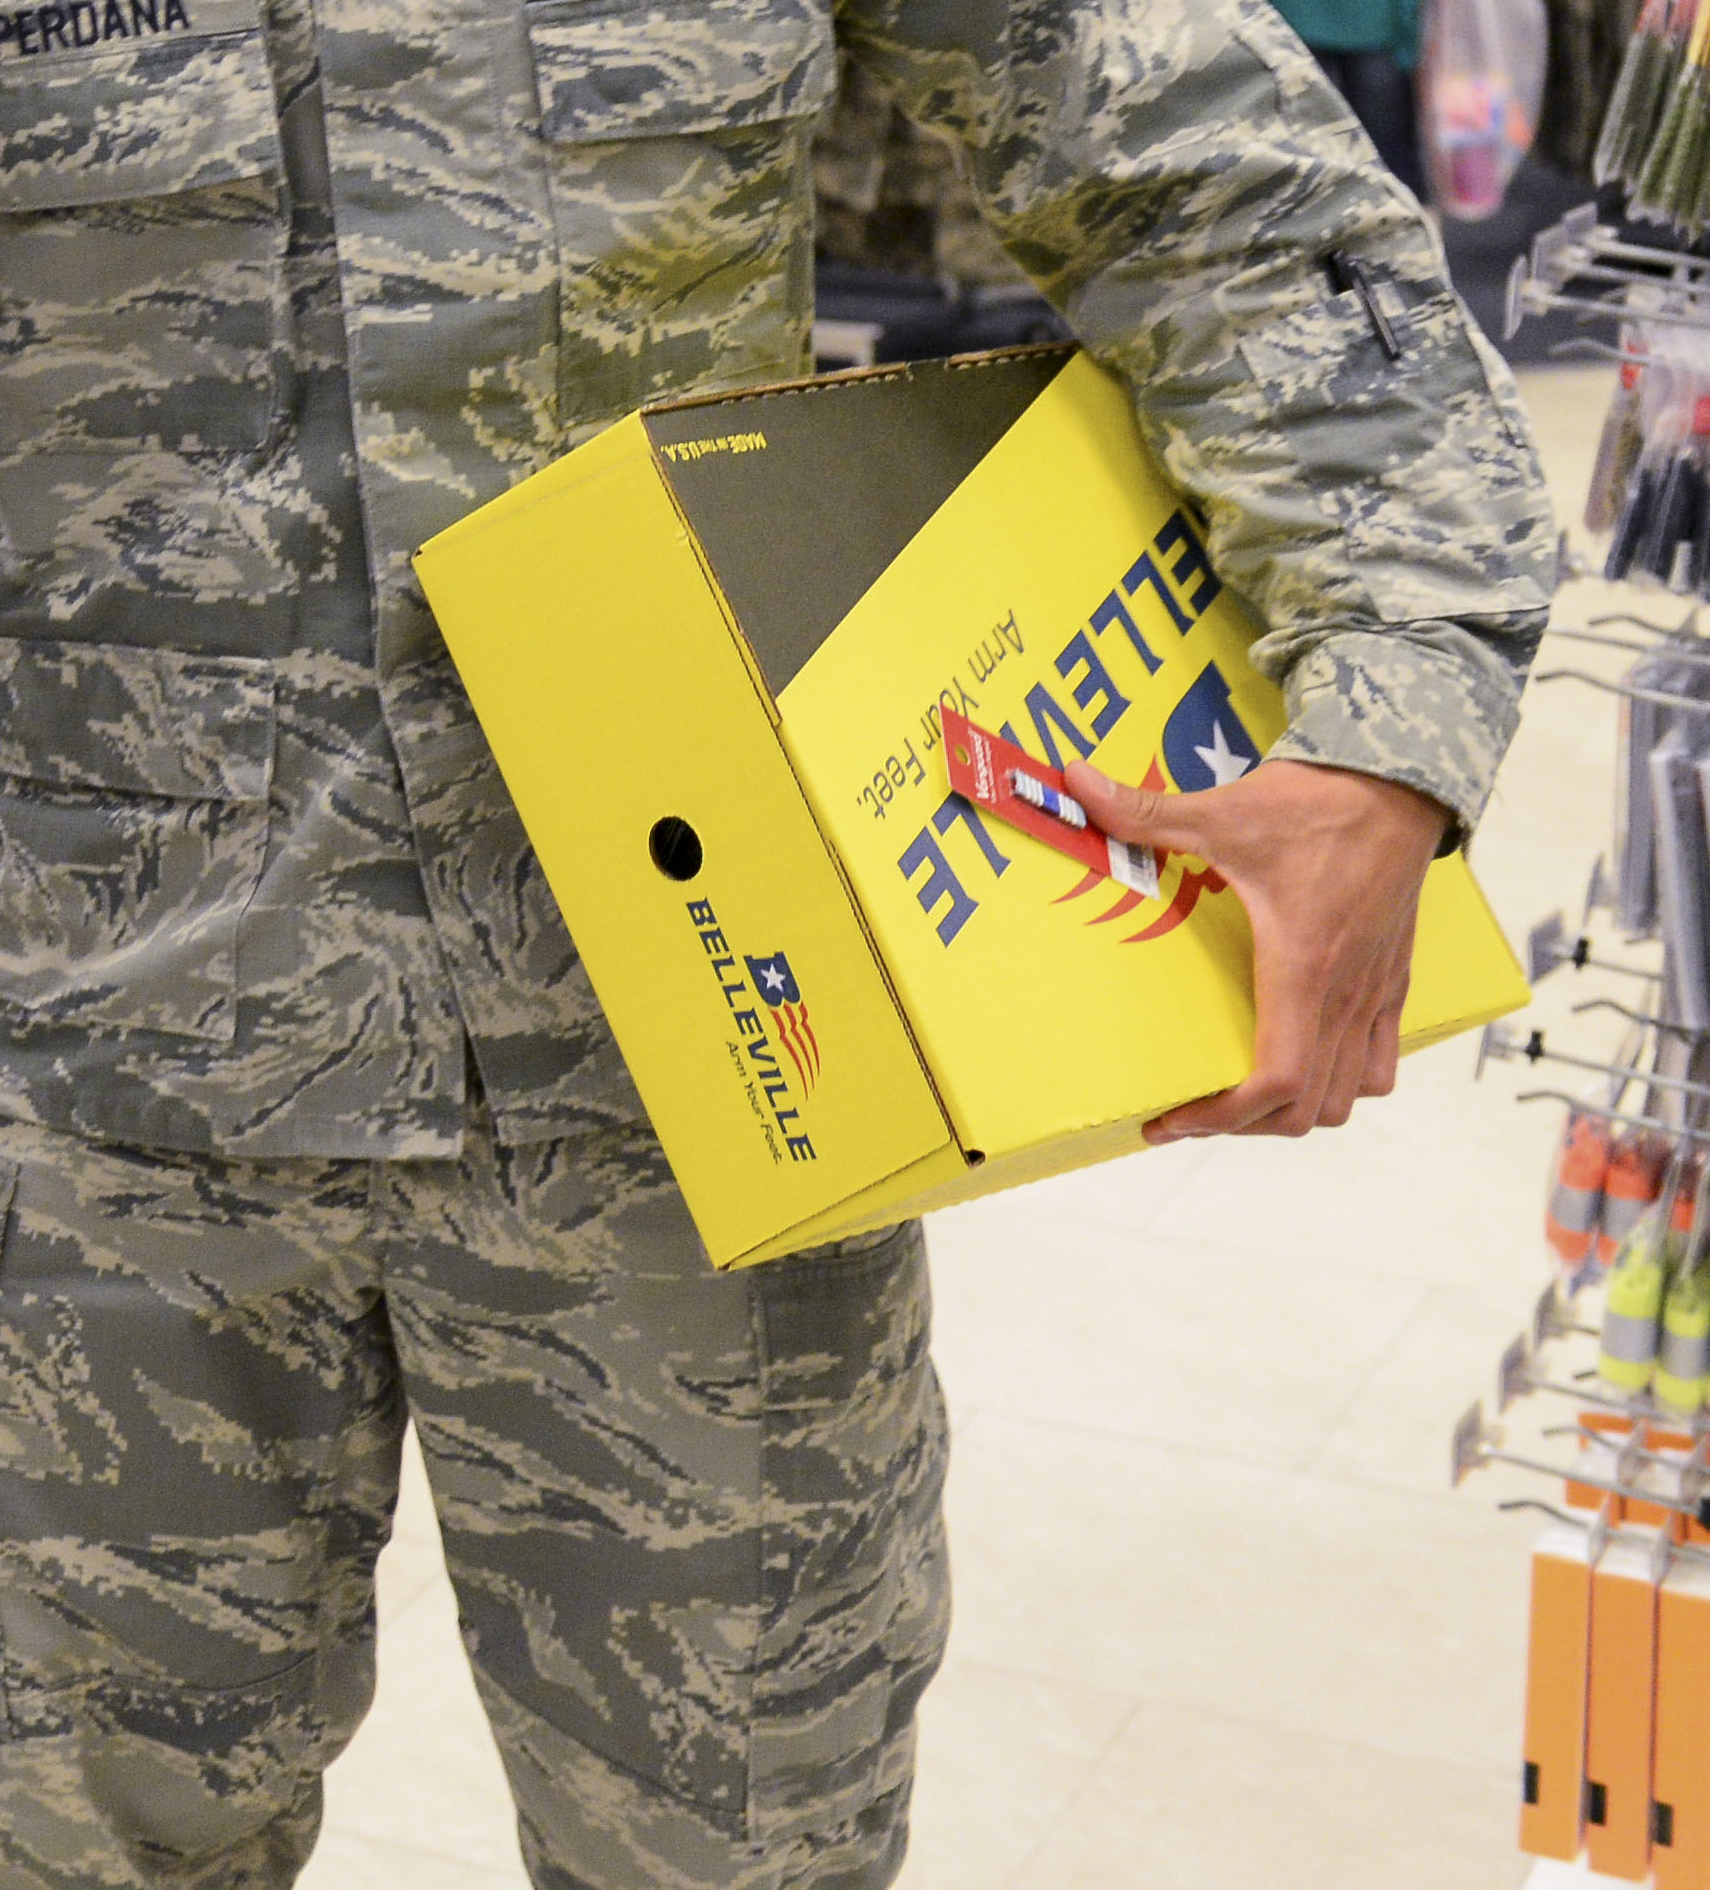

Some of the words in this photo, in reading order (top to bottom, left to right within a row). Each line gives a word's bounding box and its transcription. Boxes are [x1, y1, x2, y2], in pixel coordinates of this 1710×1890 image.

[968, 608, 1025, 683] Arm
[856, 737, 926, 819] Feet.
[686, 894, 818, 1162] BELLEVILLE
[725, 1038, 747, 1078] Arm
[743, 1079, 765, 1120] Your
